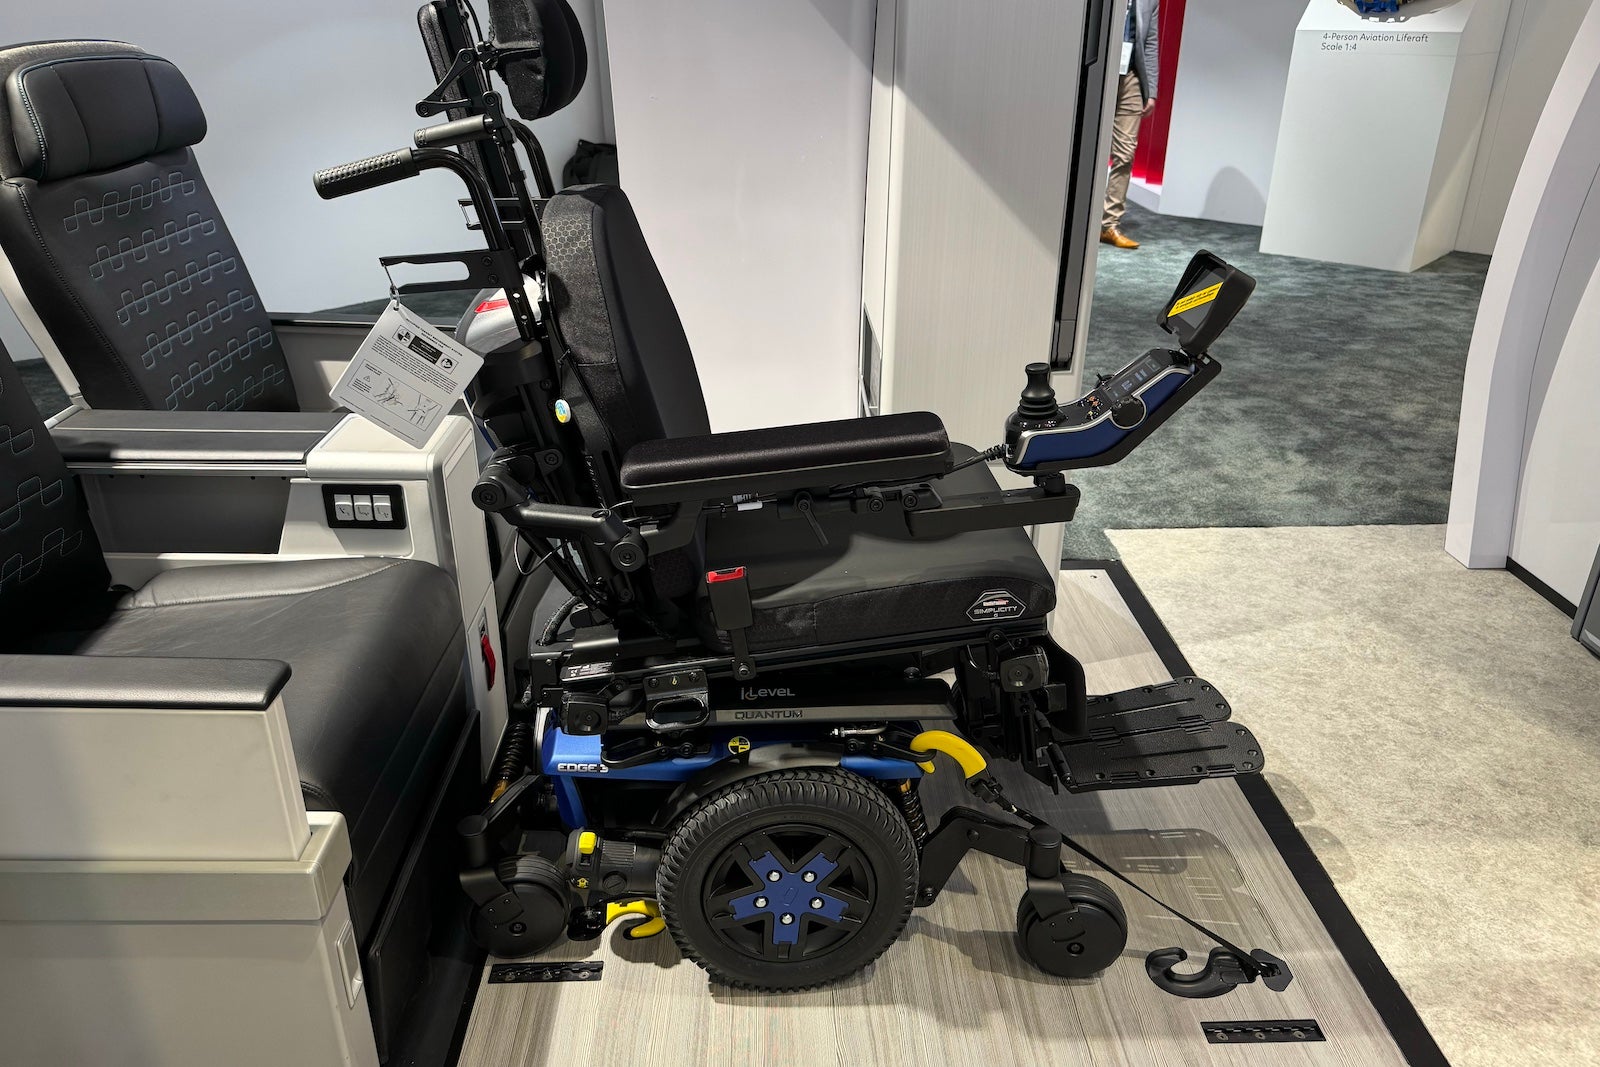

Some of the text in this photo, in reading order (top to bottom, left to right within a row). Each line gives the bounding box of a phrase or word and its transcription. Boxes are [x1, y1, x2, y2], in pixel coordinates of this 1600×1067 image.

[1323, 33, 1428, 42] 4-Person Aviation Liferaft
[974, 606, 1017, 614] SIMPLICITY
[735, 710, 803, 720] QUANTUM
[557, 763, 597, 773] EDGE
